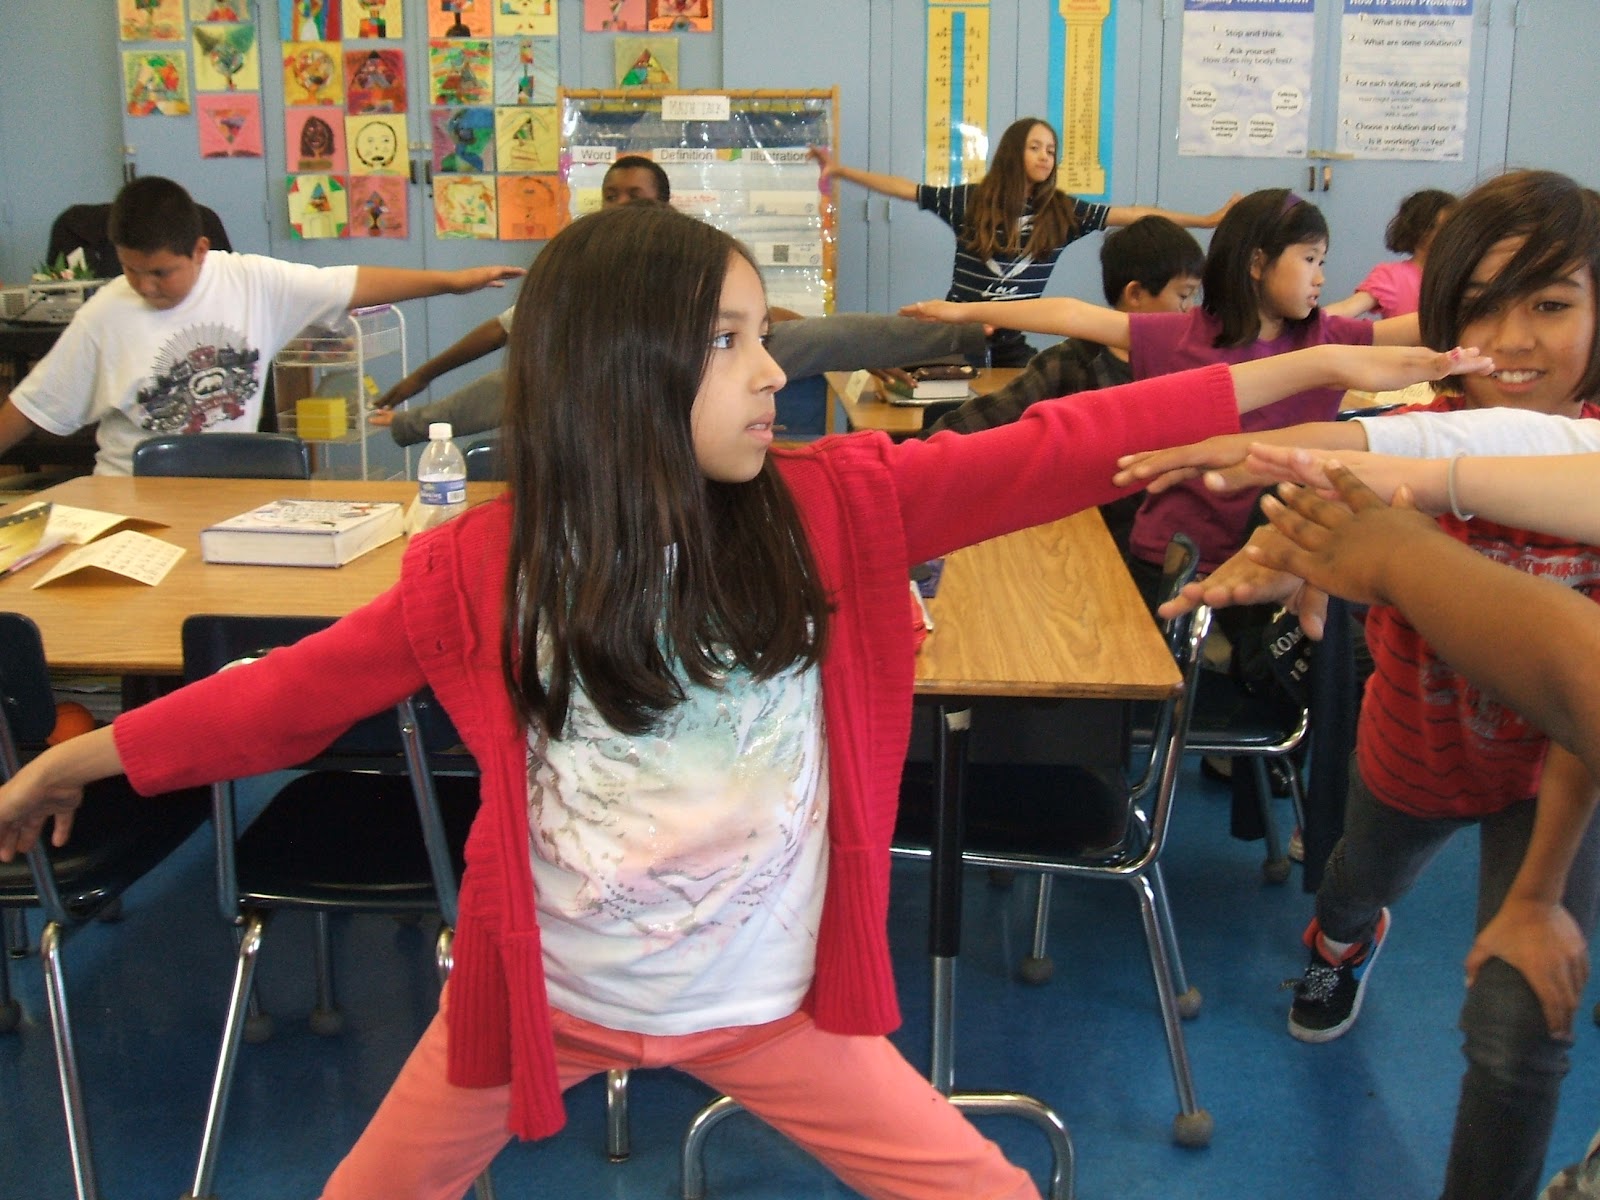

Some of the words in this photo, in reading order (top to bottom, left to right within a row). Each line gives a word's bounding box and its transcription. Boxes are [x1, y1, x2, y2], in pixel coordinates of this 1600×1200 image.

[1373, 18, 1393, 26] What
[1395, 18, 1402, 26] is
[1403, 18, 1416, 26] the
[1225, 29, 1244, 38] Stop
[1245, 29, 1260, 37] and
[580, 149, 612, 160] Word
[660, 149, 713, 161] Definition
[750, 150, 809, 162] Illutration
